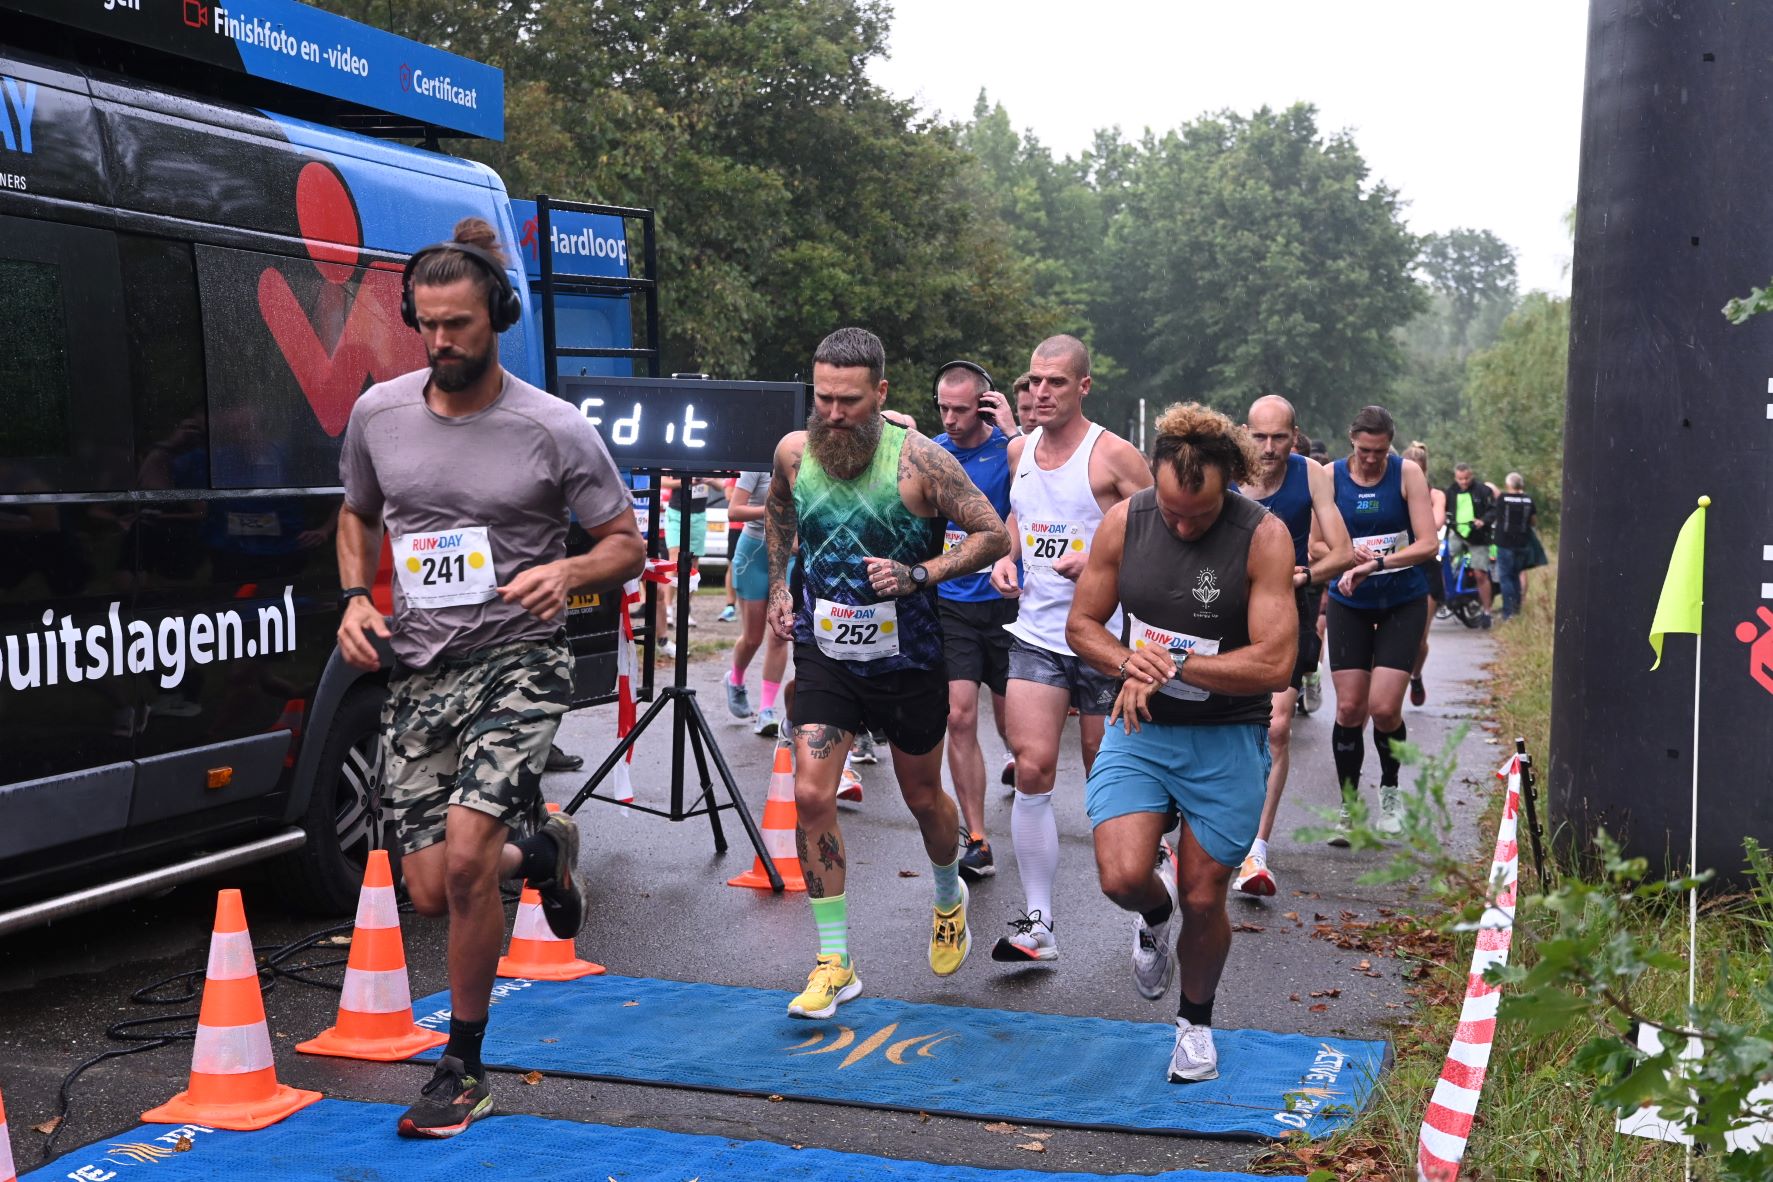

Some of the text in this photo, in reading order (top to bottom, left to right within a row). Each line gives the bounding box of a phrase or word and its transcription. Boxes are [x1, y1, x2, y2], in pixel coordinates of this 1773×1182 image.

[214, 7, 369, 77] Finishfoto en -video
[414, 69, 477, 109] Certificaat
[1034, 538, 1069, 559] 267
[422, 555, 465, 586] 241
[0, 585, 296, 690] uitslagen.nl
[835, 623, 878, 645] 252
